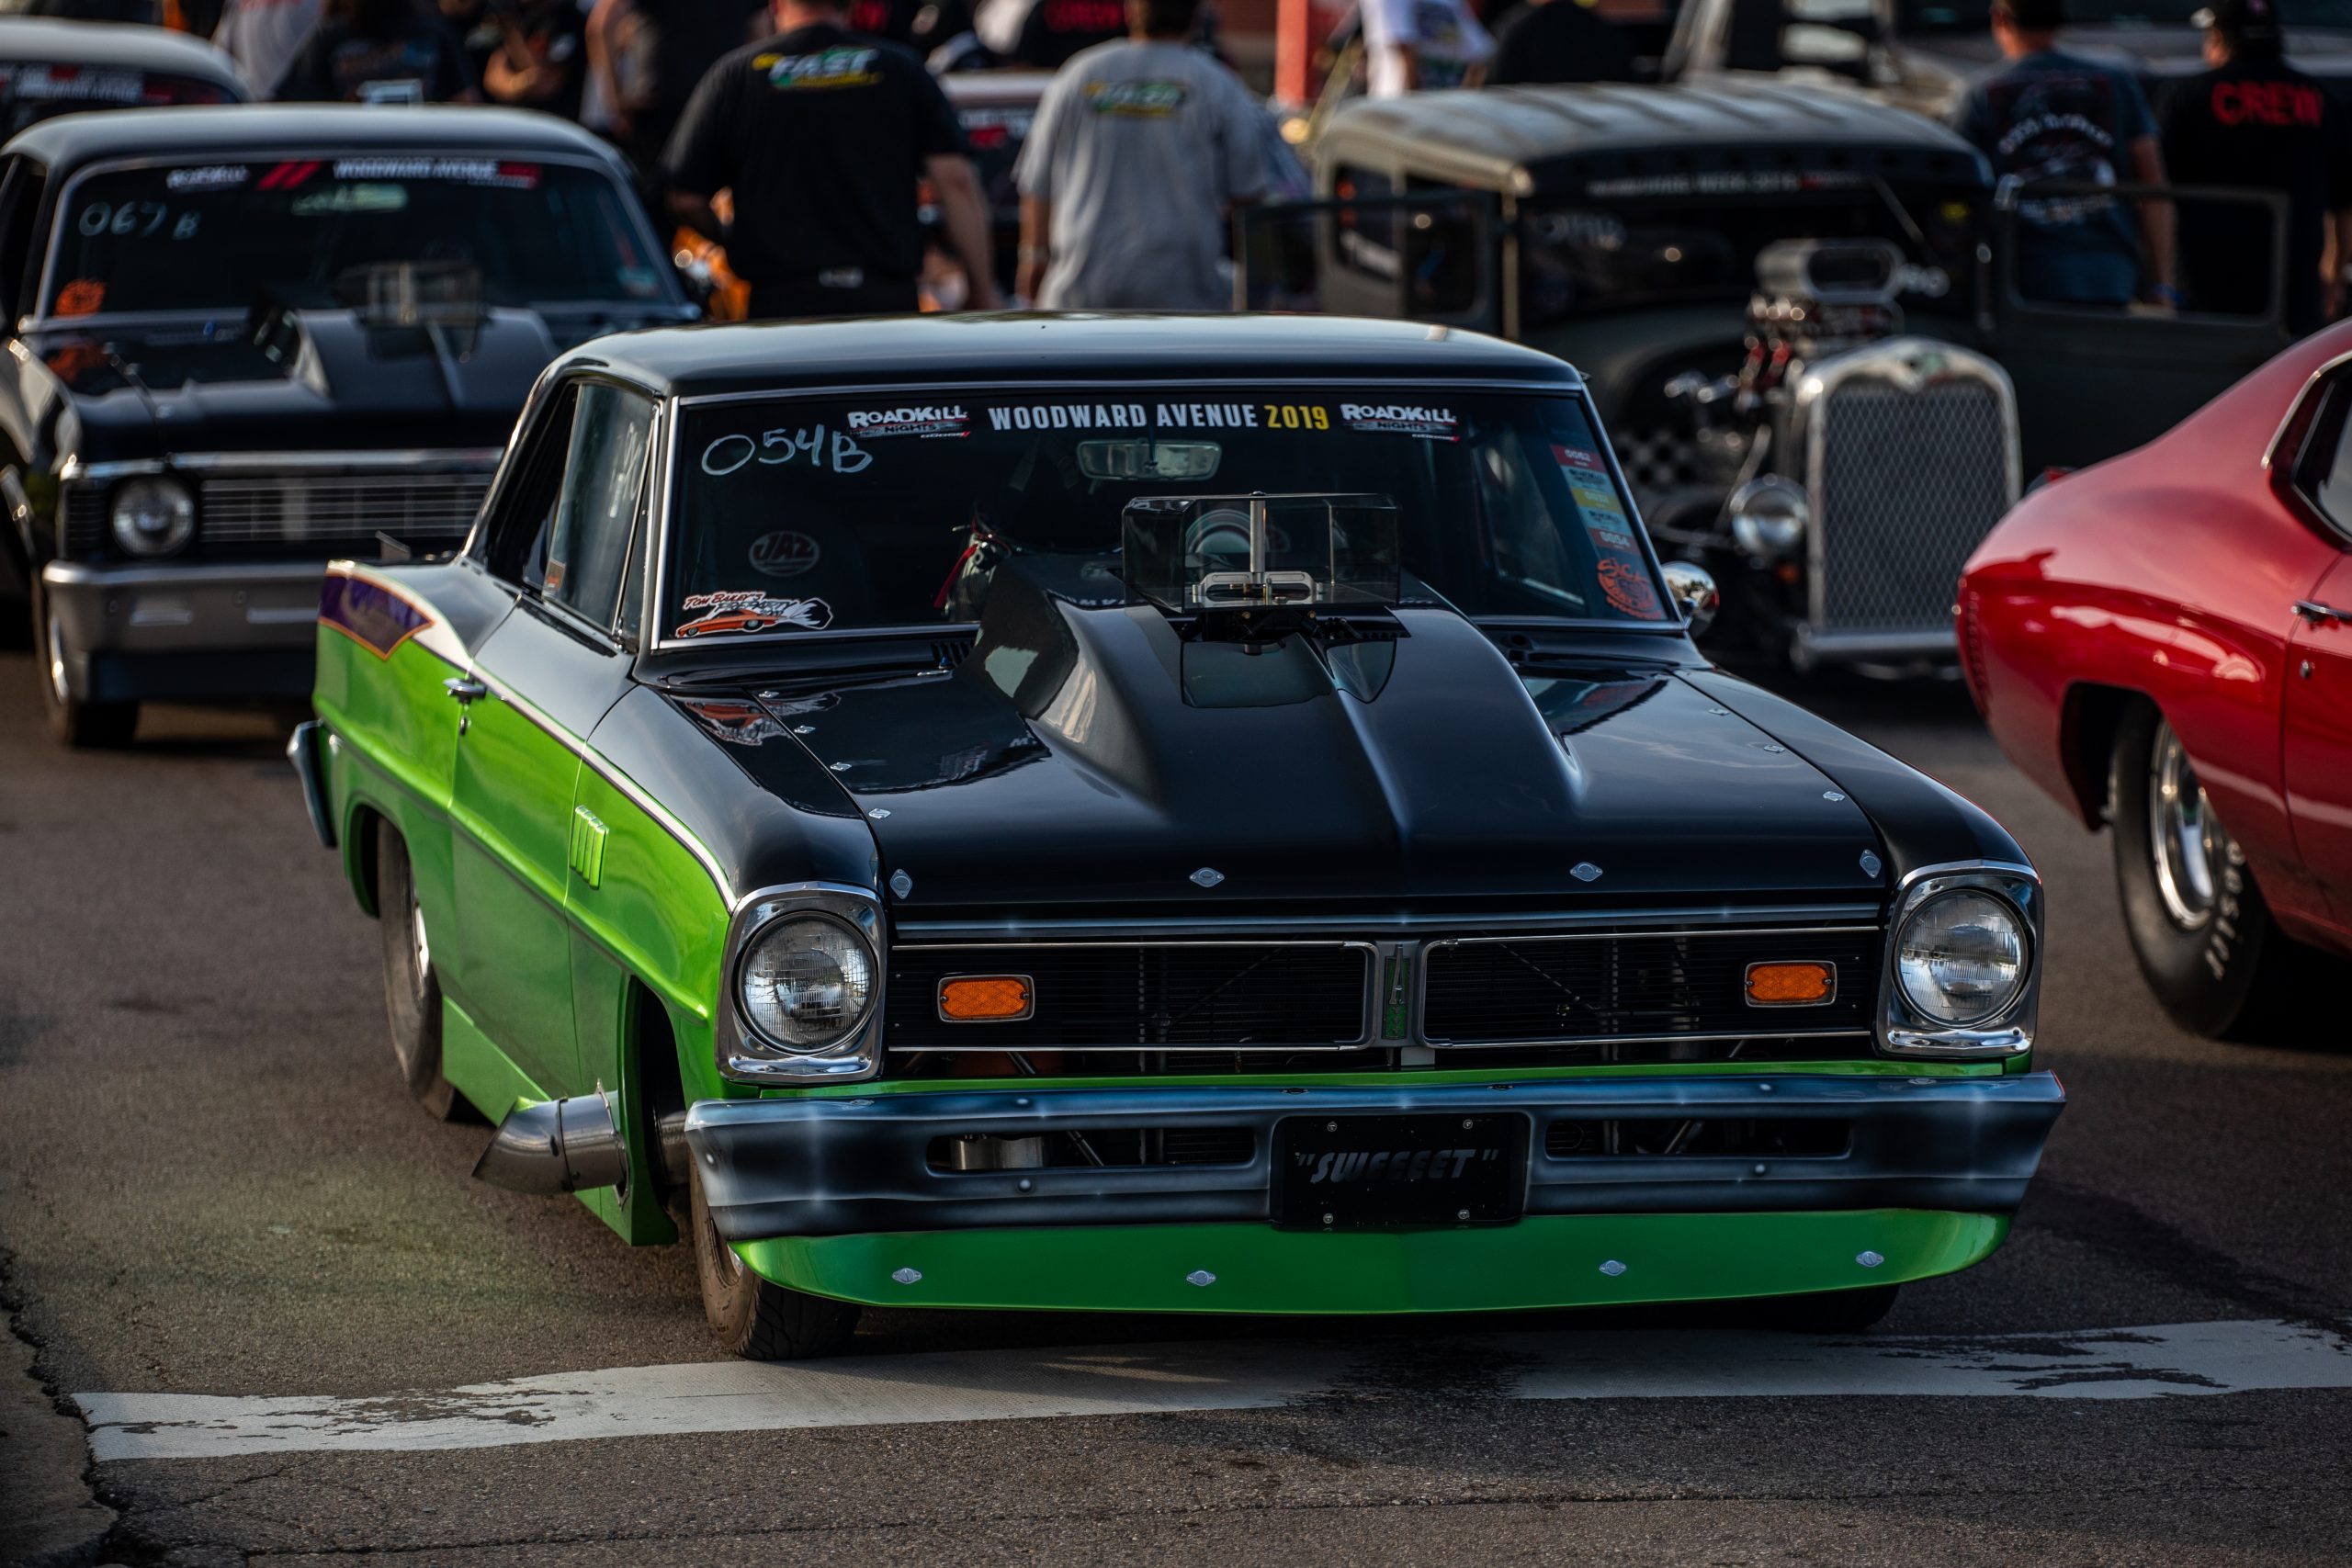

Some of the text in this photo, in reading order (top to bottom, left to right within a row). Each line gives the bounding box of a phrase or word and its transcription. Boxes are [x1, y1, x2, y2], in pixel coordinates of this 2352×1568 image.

[2210, 80, 2324, 127] CREW
[848, 405, 967, 428] ROADKILL
[988, 402, 1329, 431] WOODWARD AVENUE 2019
[1340, 403, 1457, 423] ROADKILL
